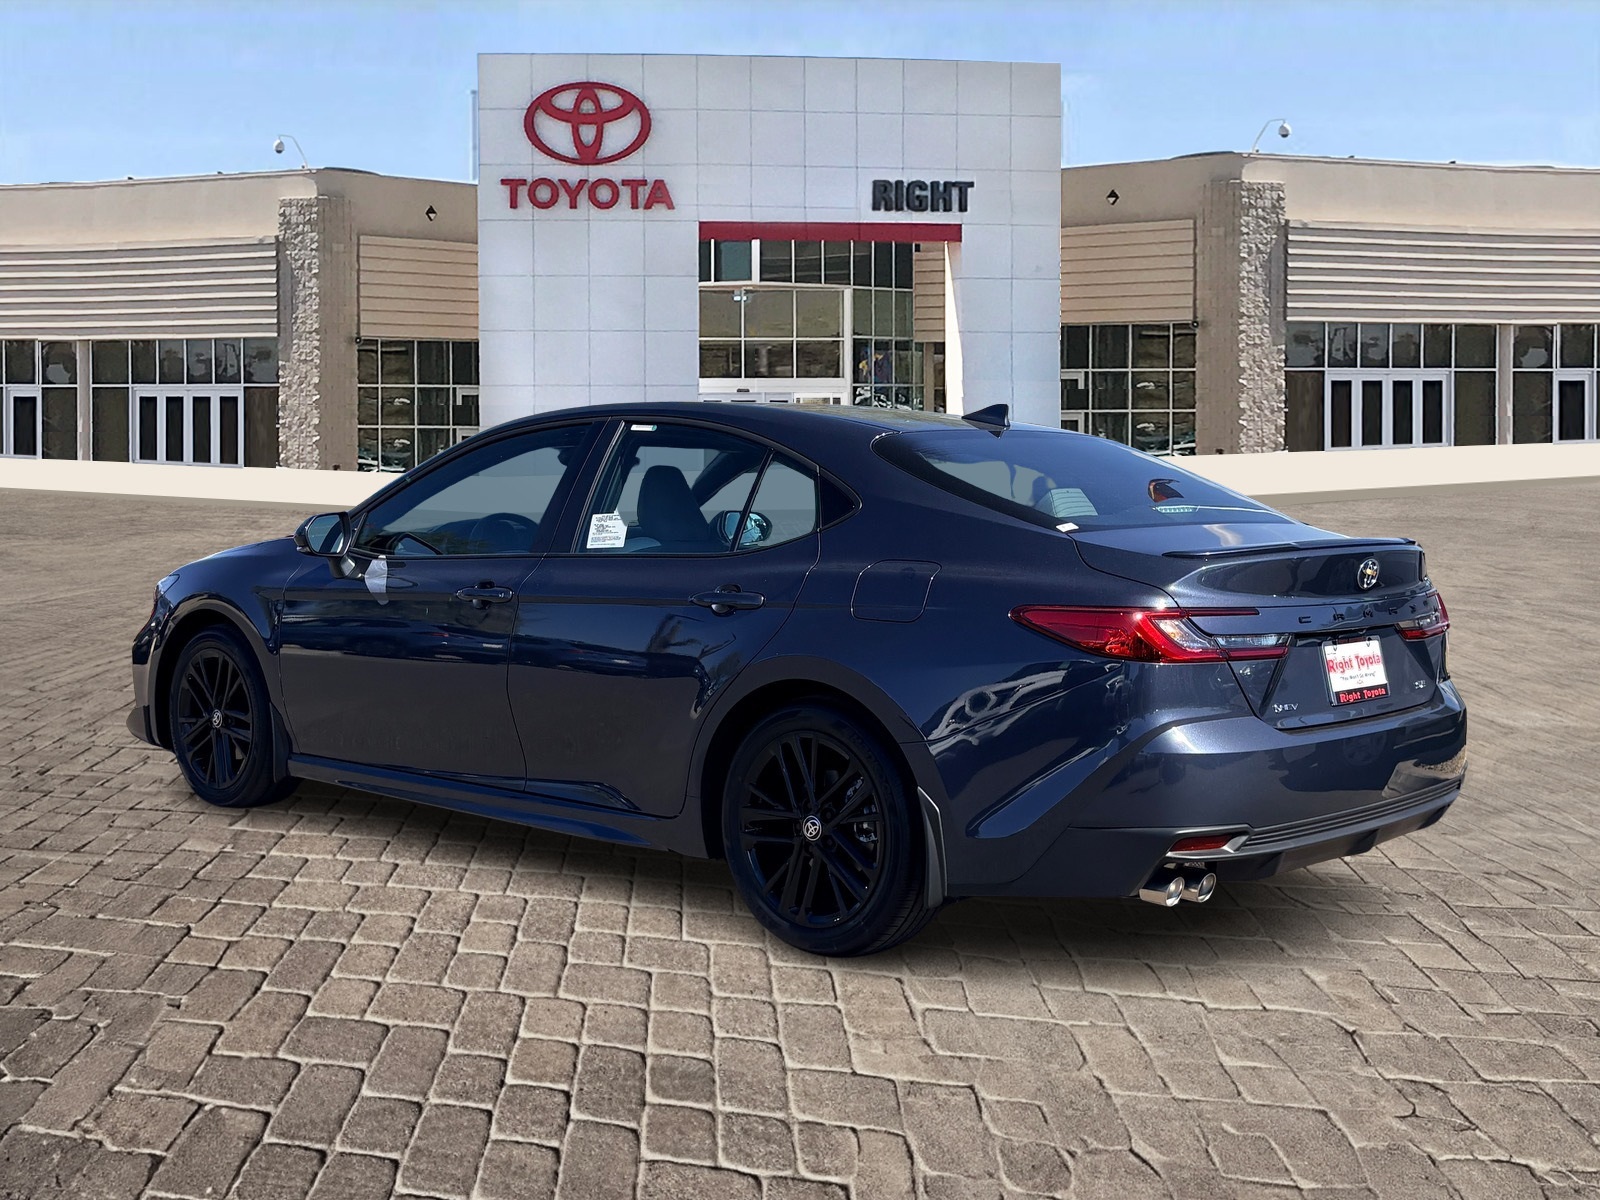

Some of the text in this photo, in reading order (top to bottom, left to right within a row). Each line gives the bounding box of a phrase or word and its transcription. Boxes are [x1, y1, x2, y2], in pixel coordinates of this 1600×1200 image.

[500, 178, 675, 209] TOYOTA
[872, 180, 974, 212] RIGHT
[1327, 652, 1381, 673] Right Toyota
[1340, 688, 1386, 703] Right Toyota
